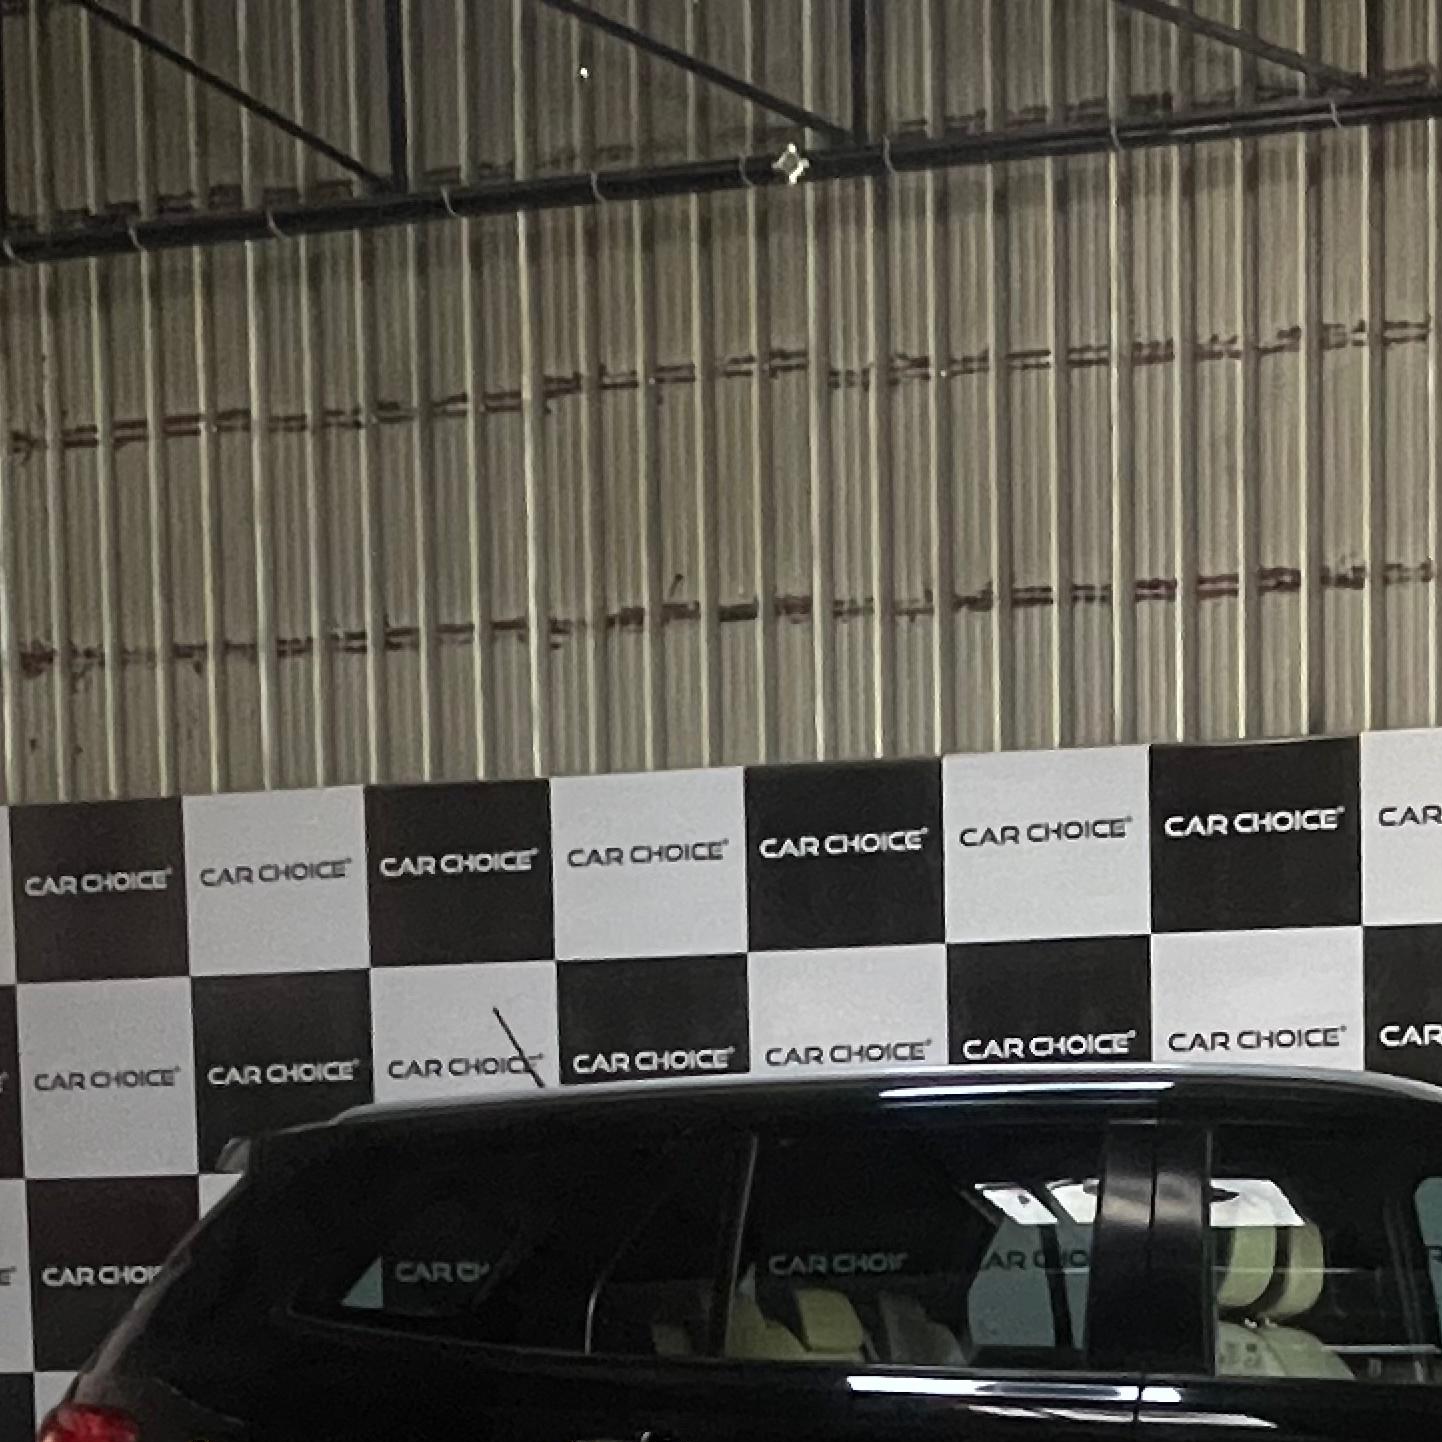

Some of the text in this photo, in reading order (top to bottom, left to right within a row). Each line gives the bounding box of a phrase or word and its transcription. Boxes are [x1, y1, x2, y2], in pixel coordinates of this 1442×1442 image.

[1165, 814, 1228, 836] CAR
[1379, 806, 1442, 826] CAR
[959, 826, 1019, 846] CAR
[759, 836, 819, 858] CAR
[380, 856, 435, 876] CAR
[567, 848, 623, 867] CAR
[25, 876, 77, 896] CAR
[200, 866, 253, 886] CAR
[963, 1038, 1024, 1060] CAR
[1169, 1032, 1230, 1052] CAR
[573, 1052, 629, 1074] CAR
[765, 1047, 823, 1066] CAR
[207, 1066, 261, 1085] CAR
[387, 1060, 443, 1079] CAR
[35, 1072, 85, 1091] CAR
[768, 1255, 827, 1275] CAR
[983, 1250, 1026, 1271] AR
[43, 1267, 96, 1287] CAR
[395, 1261, 453, 1283] CAR
